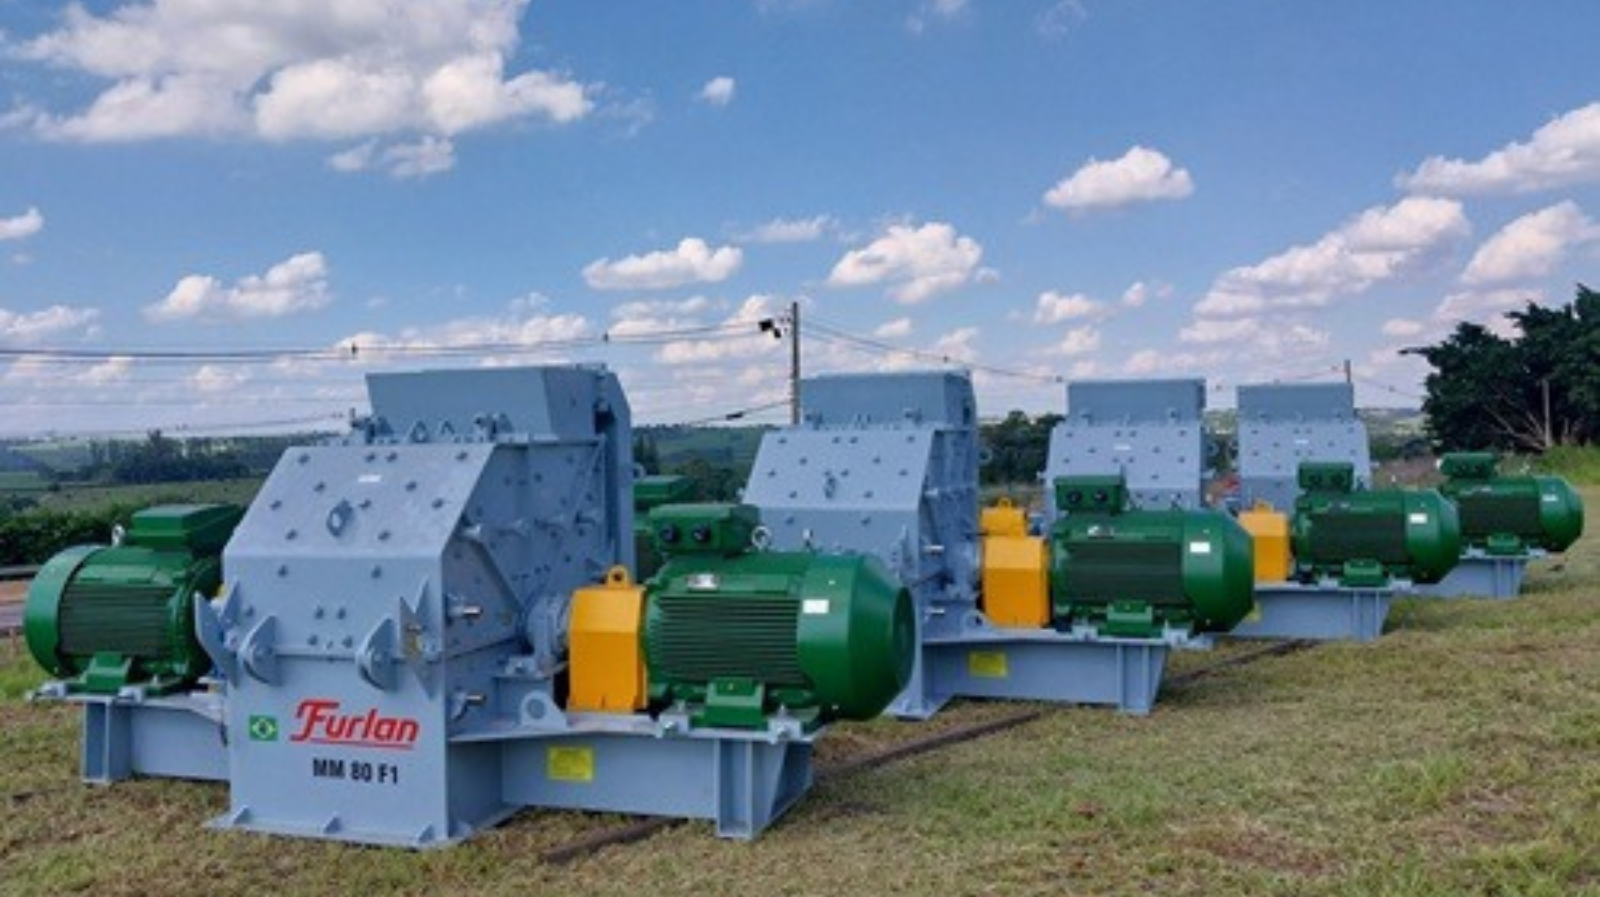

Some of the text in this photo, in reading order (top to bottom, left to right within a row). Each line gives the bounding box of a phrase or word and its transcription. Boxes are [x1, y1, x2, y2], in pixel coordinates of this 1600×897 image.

[290, 699, 419, 743] Furlan
[313, 758, 398, 784] MM 80 F1
